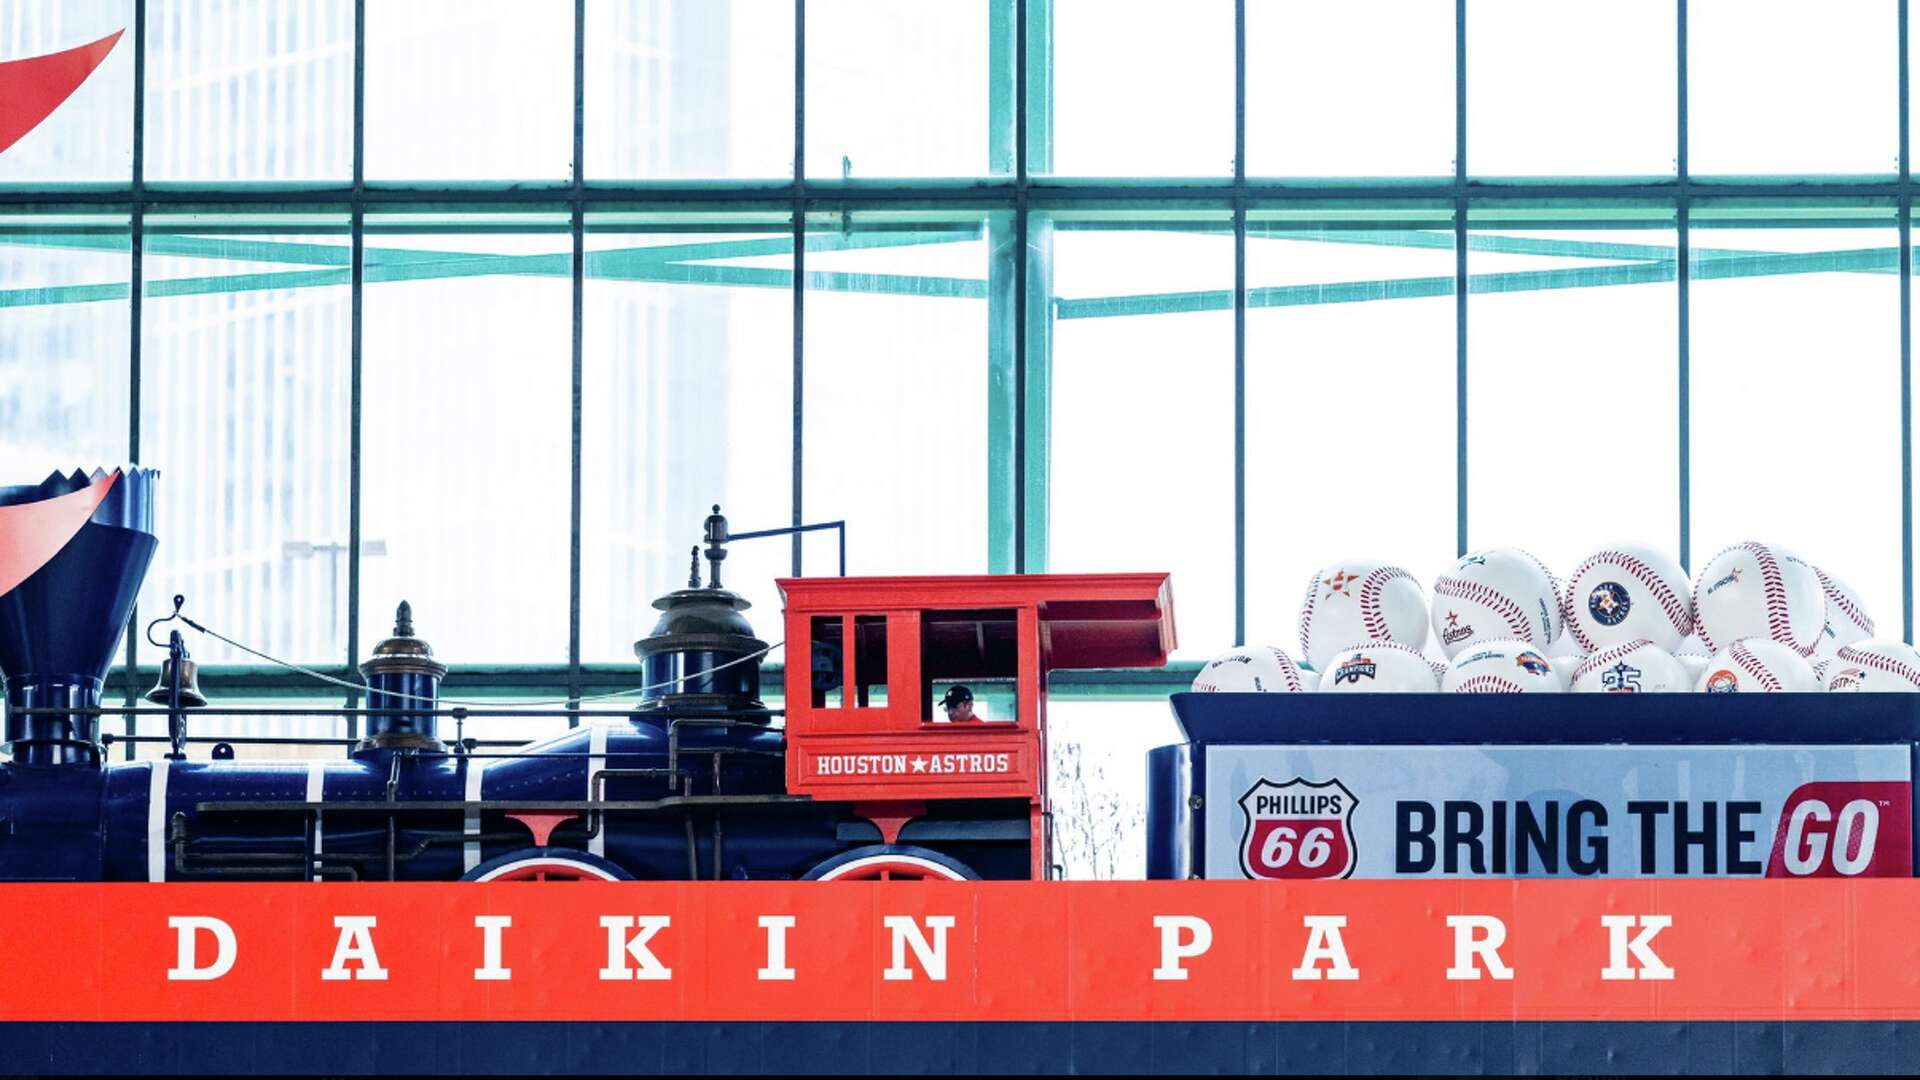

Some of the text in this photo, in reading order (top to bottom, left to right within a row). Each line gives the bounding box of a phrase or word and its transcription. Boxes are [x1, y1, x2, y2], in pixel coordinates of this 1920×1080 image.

[817, 754, 1009, 775] HOUSTON ASTROS
[1256, 795, 1342, 815] PHILLIPS
[1260, 827, 1335, 869] 66
[1395, 799, 1609, 876] BRING
[1627, 801, 1763, 875] THE
[1784, 799, 1879, 876] GO
[167, 914, 1675, 981] DAIKIN PARK
